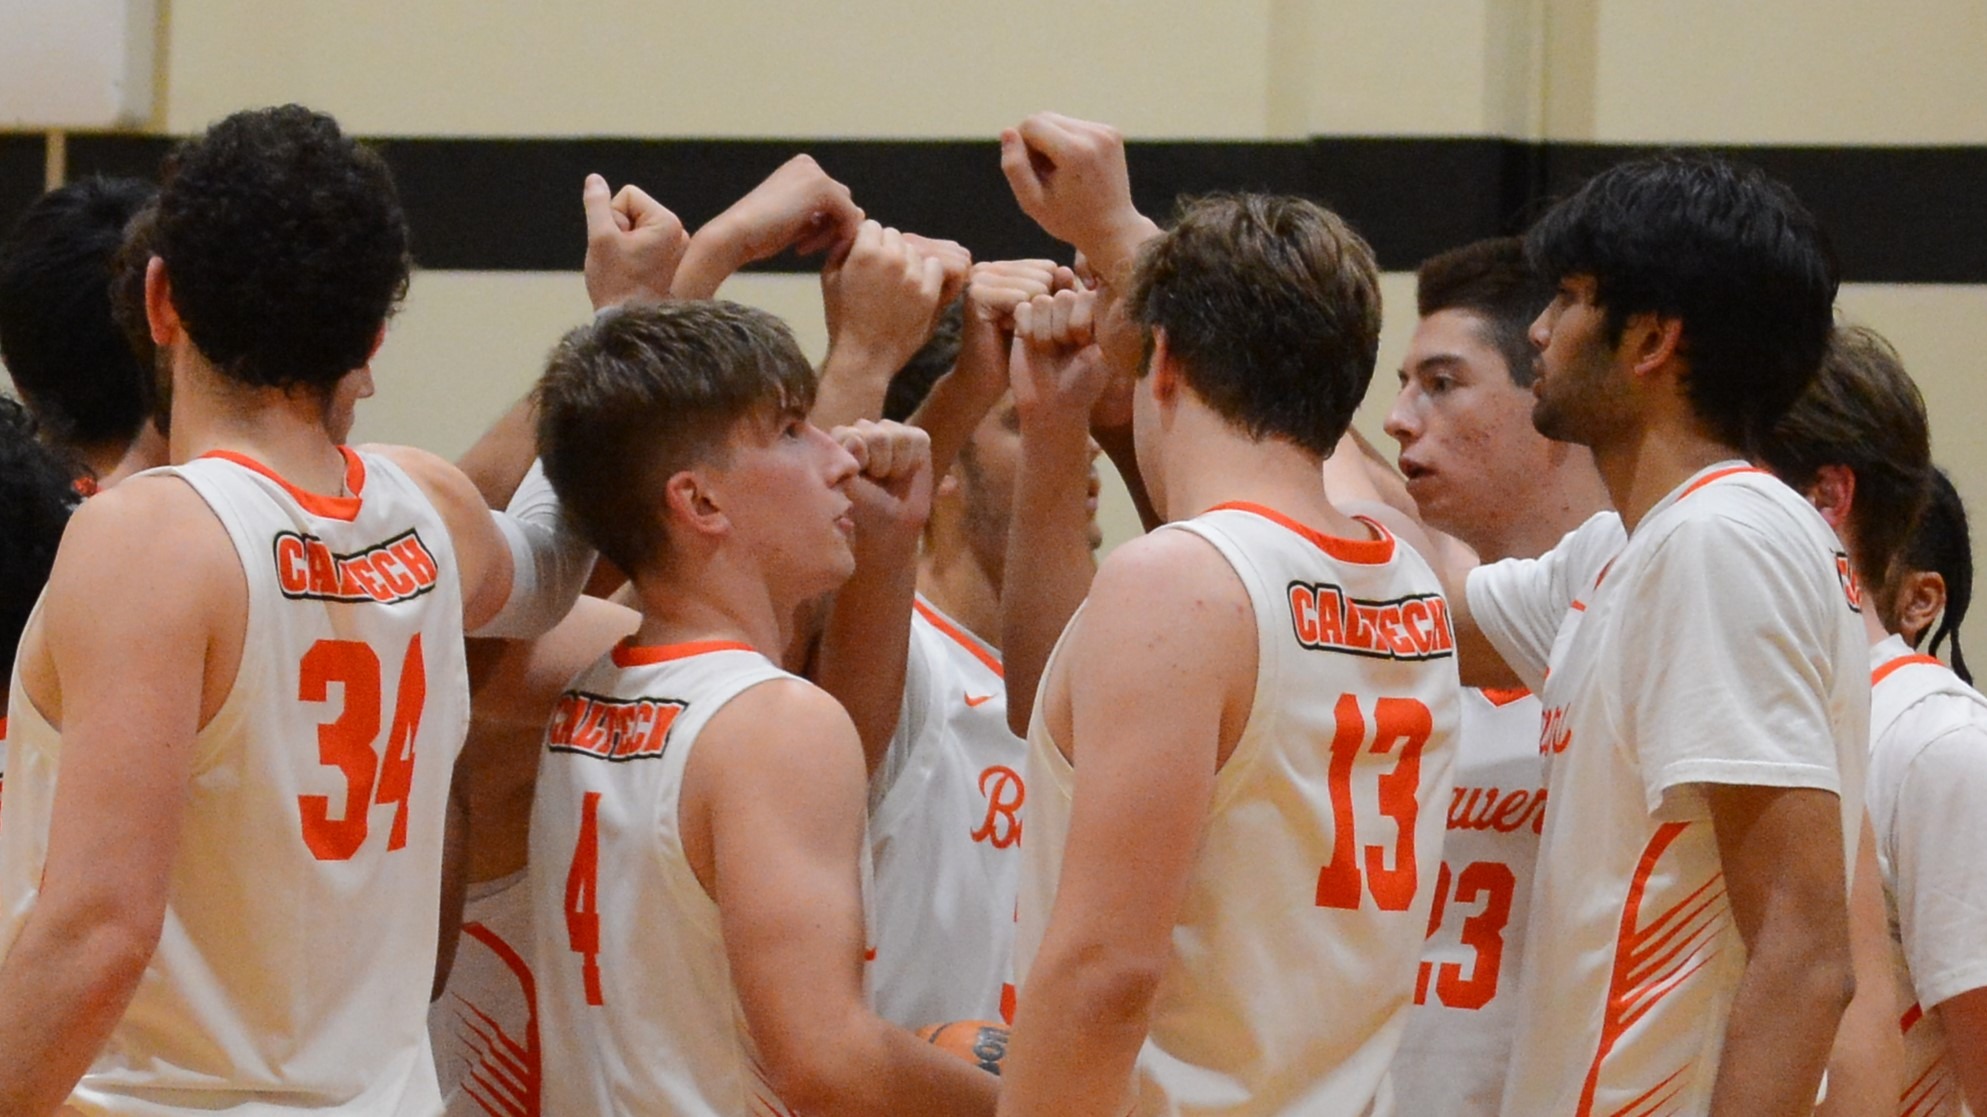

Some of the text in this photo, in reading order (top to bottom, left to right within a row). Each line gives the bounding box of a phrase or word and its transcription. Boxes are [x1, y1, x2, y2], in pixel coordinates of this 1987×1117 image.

[1288, 581, 1454, 659] CALTECH
[298, 632, 426, 861] 34
[1316, 692, 1432, 911] 13
[565, 791, 604, 1006] 4
